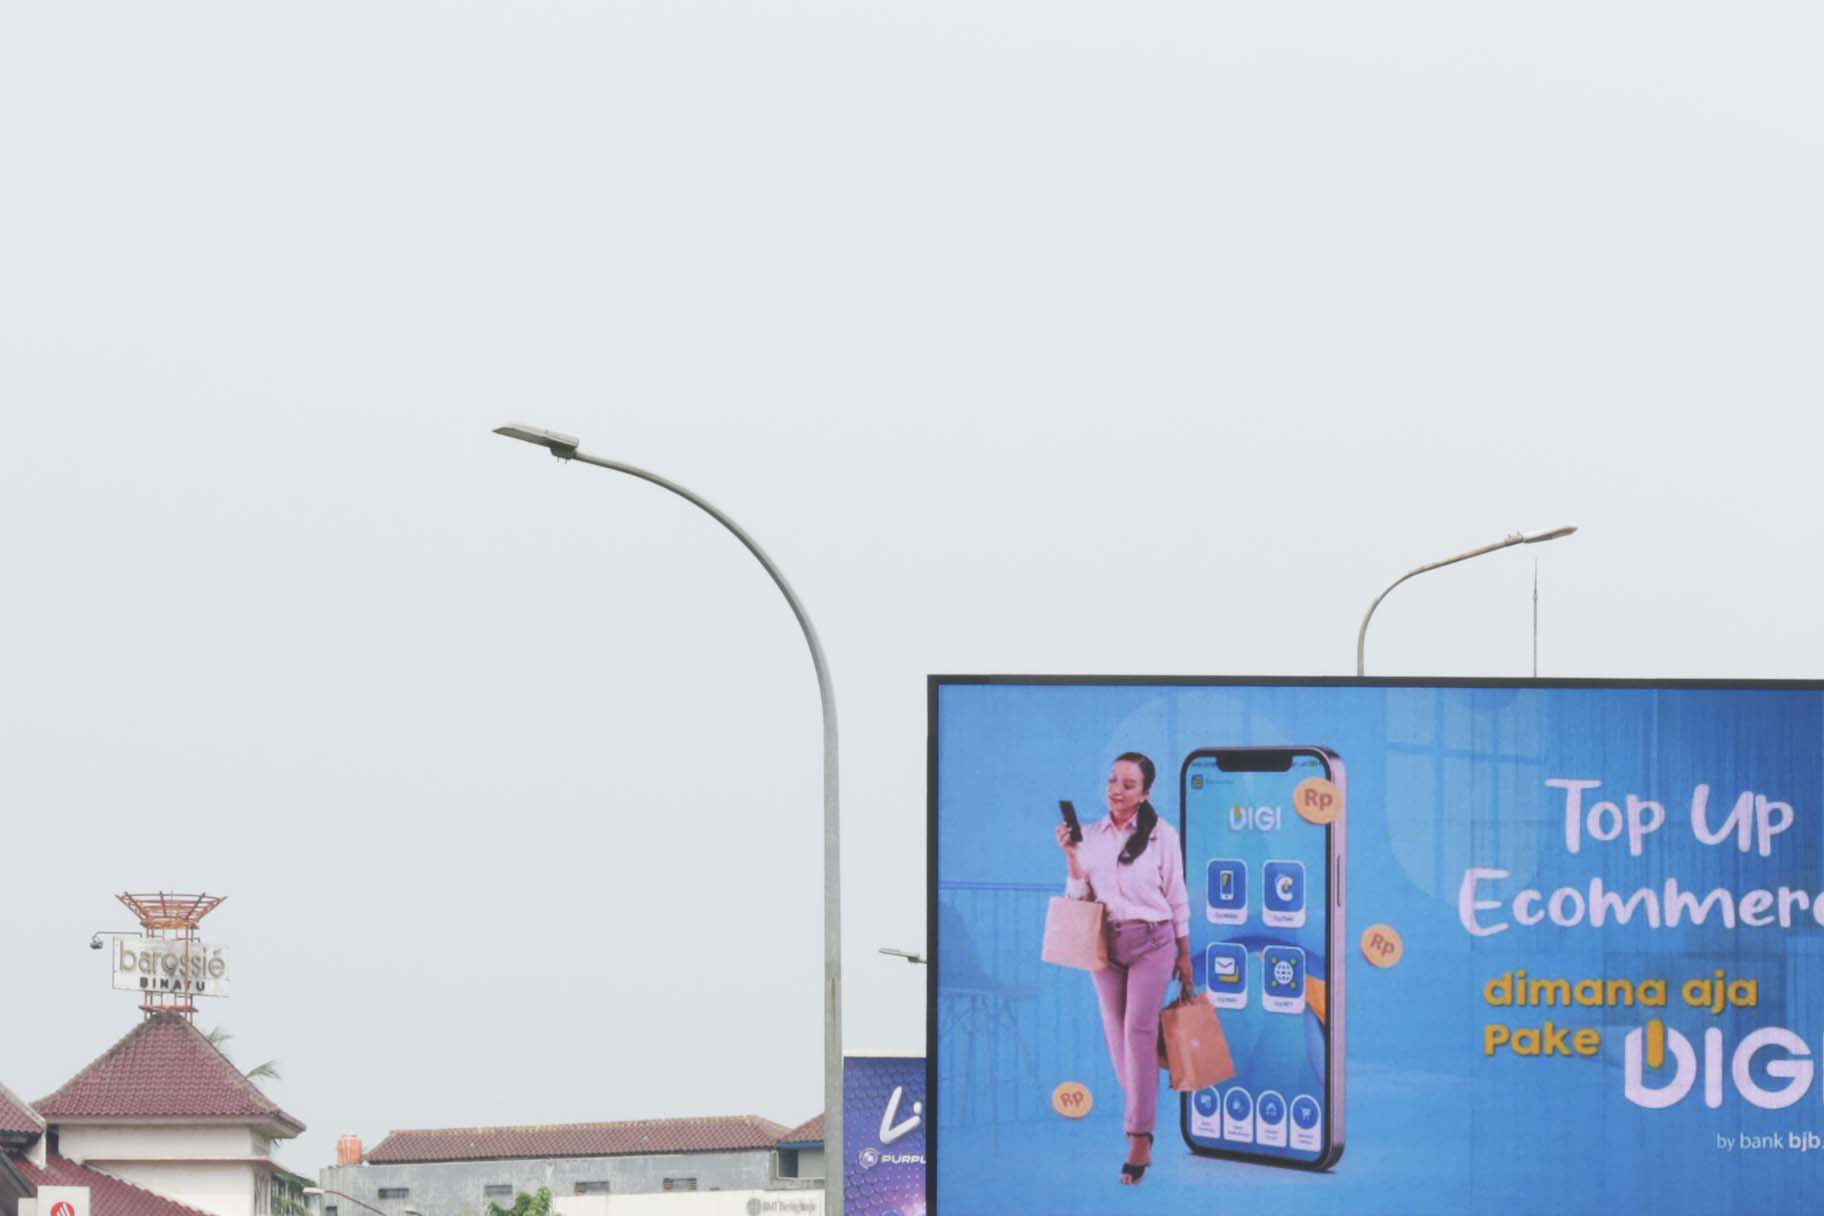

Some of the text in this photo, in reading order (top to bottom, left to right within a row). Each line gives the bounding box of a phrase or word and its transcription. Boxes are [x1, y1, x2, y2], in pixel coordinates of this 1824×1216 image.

[1304, 788, 1334, 812] Rp
[1229, 804, 1283, 832] DIGI
[1544, 778, 1795, 857] Top Up
[1370, 932, 1395, 958] Rp
[1484, 970, 1759, 1015] dimana aja
[1484, 1020, 1601, 1056] Pake
[1060, 1089, 1085, 1109] Rp
[1716, 1130, 1821, 1153] by bank bjb
[881, 1154, 927, 1165] PURPL
